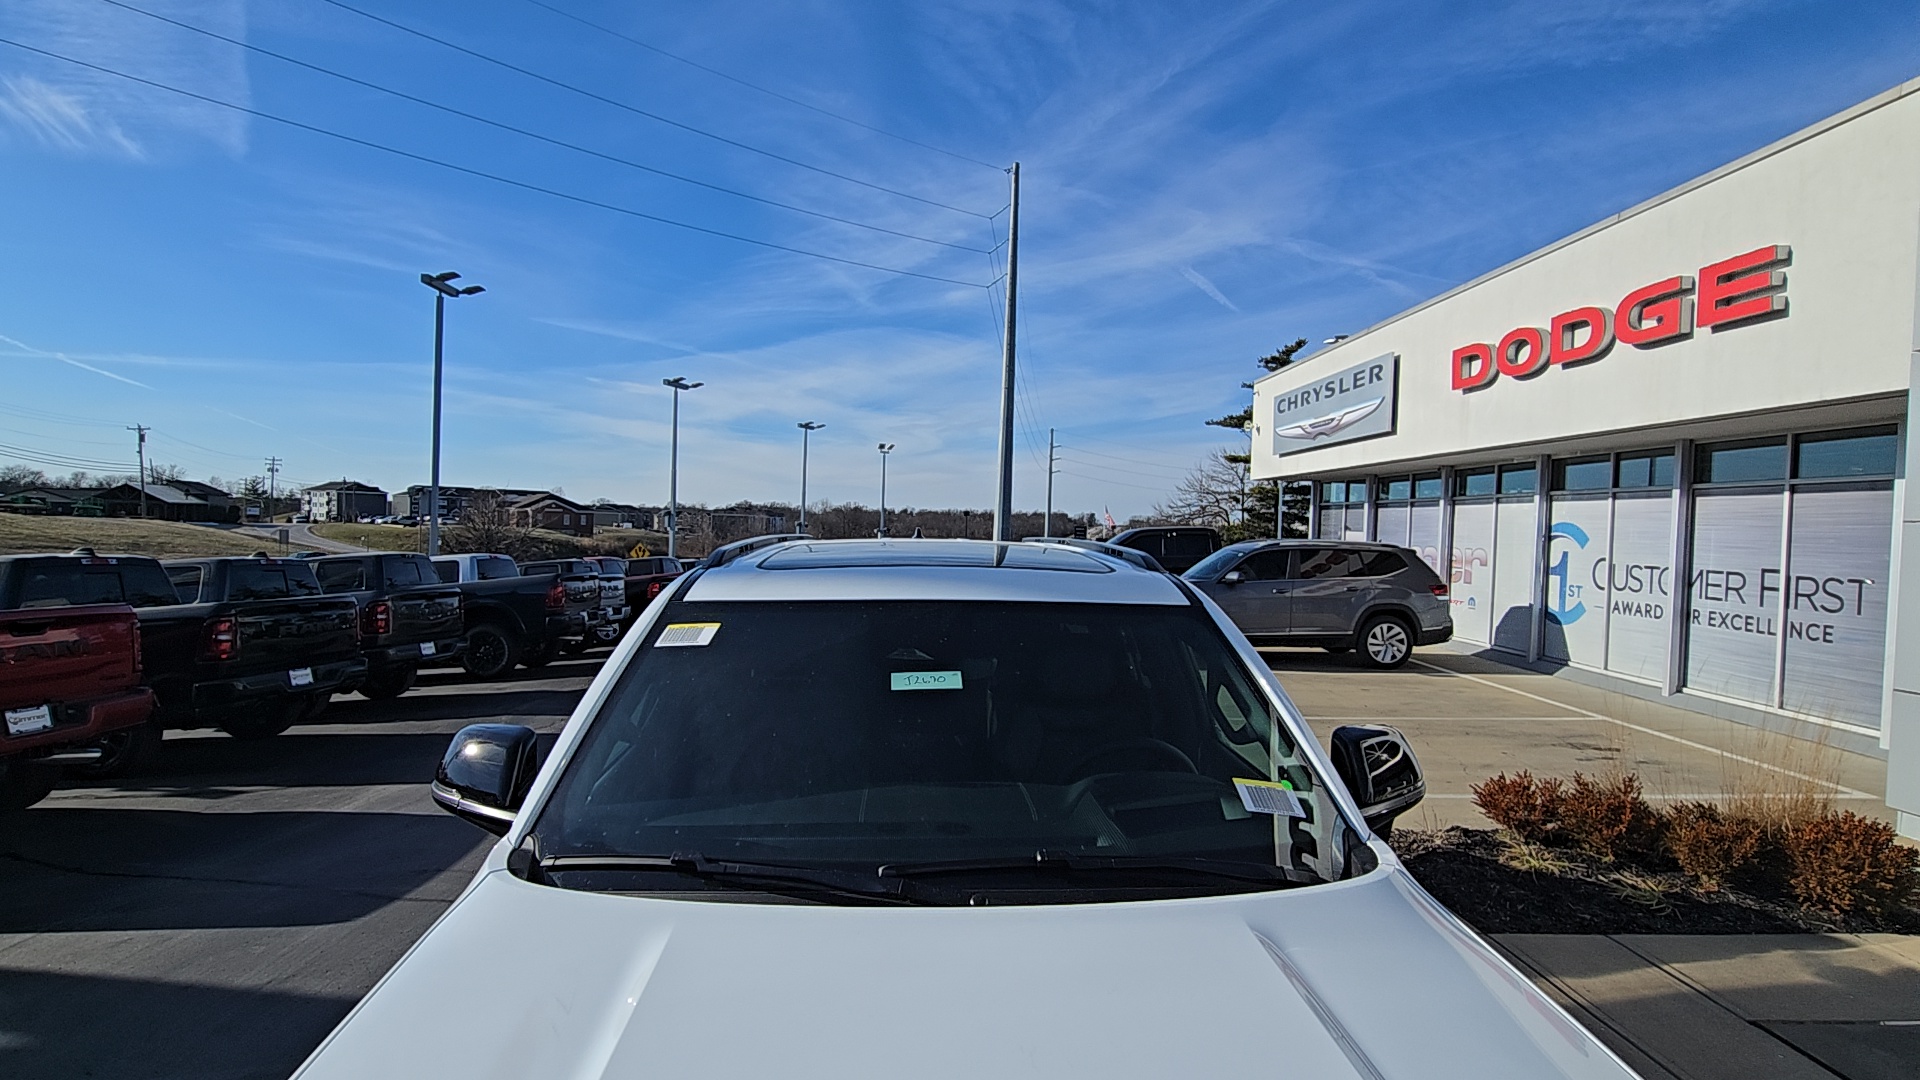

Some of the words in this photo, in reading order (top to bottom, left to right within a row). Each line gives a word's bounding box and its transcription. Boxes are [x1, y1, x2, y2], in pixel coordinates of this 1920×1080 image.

[1451, 244, 1790, 392] DODGE
[1277, 363, 1384, 414] CHRYSLER
[1759, 568, 1876, 616] FIRST
[1611, 600, 1664, 620] AWARD
[1708, 610, 1835, 644] EXCELLNCE
